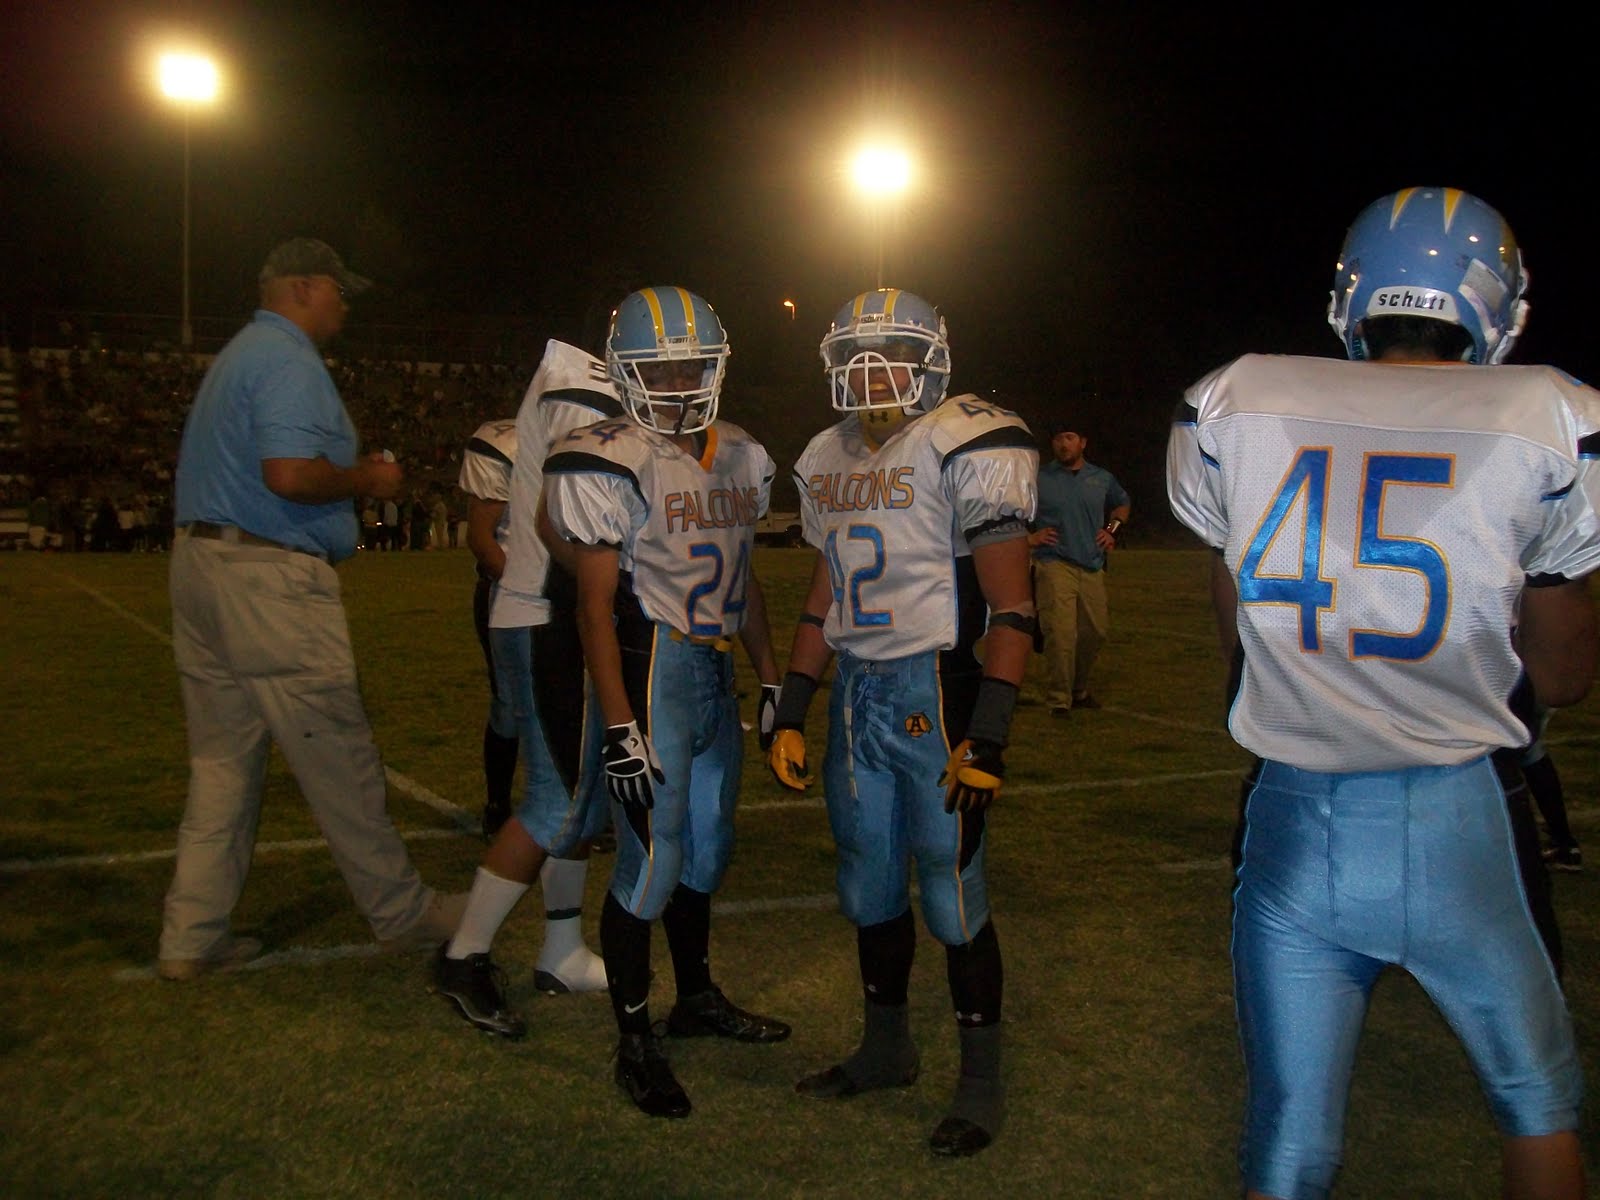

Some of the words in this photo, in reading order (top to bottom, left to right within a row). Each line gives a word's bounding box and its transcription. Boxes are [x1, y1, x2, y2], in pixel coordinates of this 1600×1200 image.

[664, 486, 759, 534] FALCONS
[808, 466, 915, 514] FALCONS
[687, 539, 752, 638] 24
[1237, 445, 1456, 664] 45
